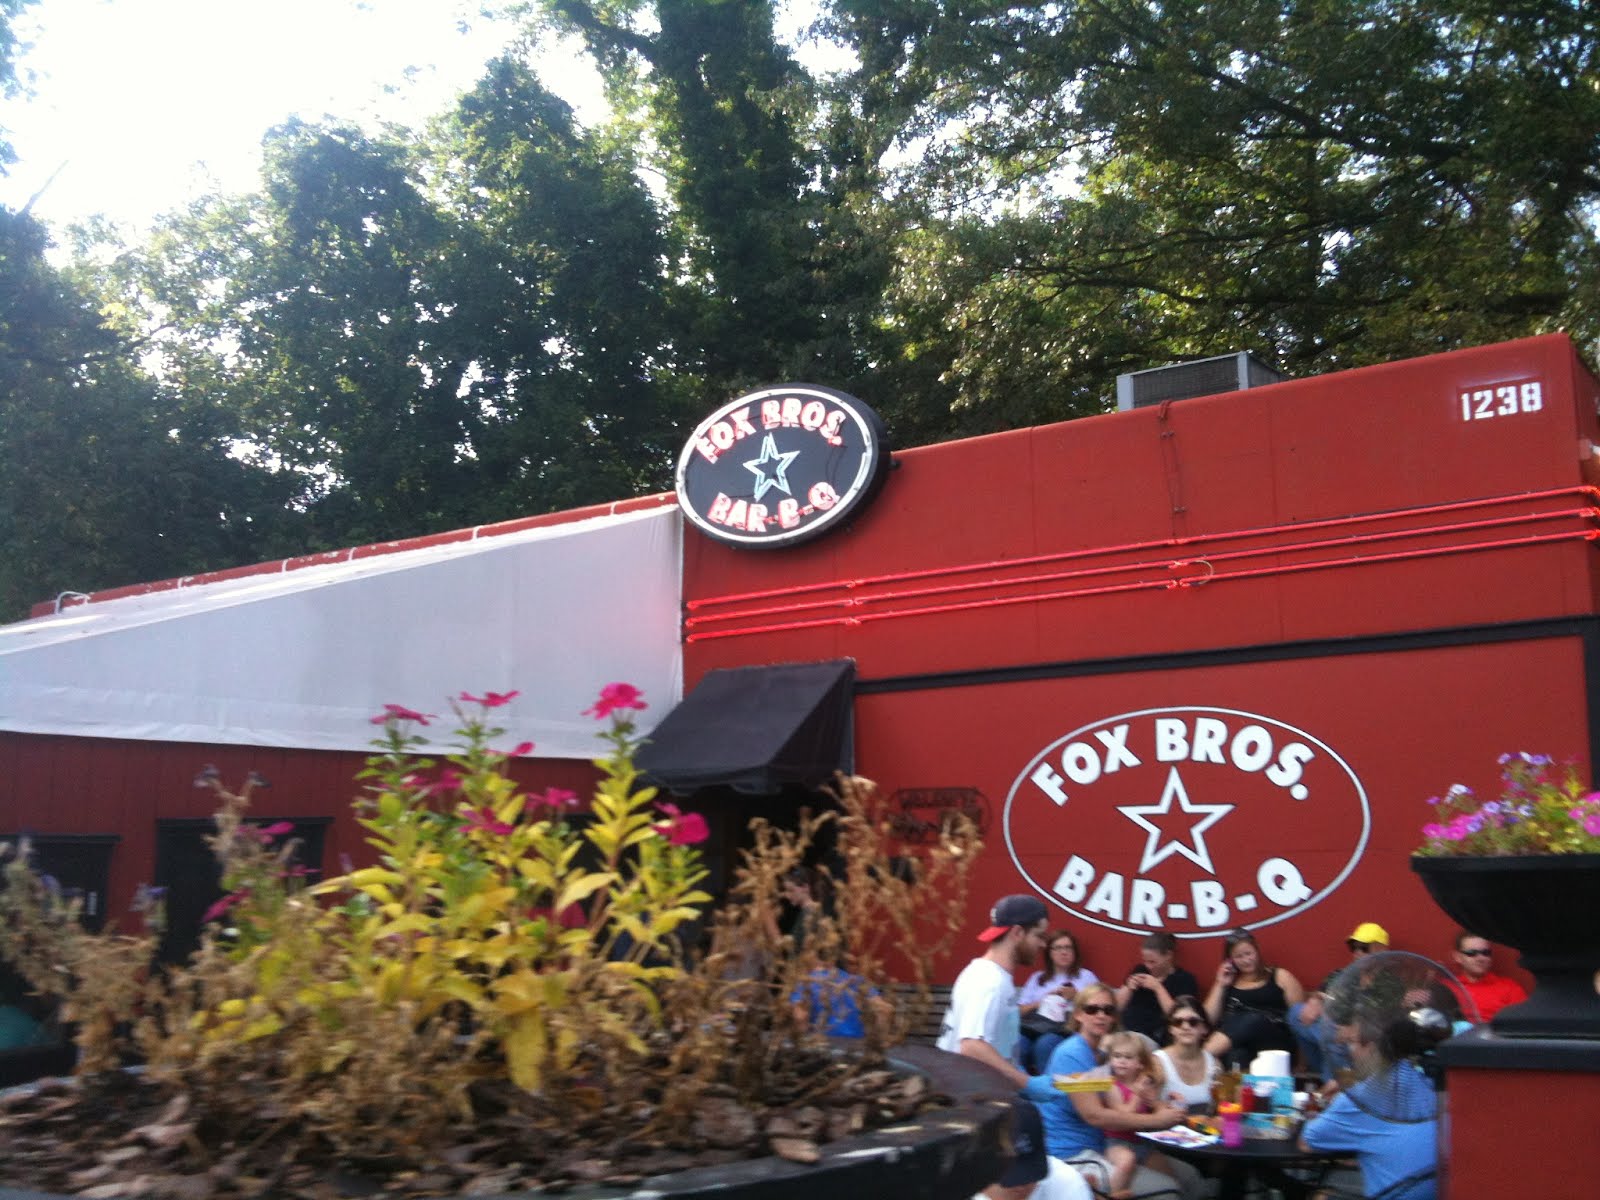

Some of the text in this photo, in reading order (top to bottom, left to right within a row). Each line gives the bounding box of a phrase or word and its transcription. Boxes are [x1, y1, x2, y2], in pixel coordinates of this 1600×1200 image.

[1461, 381, 1542, 421] 1238
[696, 406, 757, 464] FOX
[707, 481, 840, 533] BAR-B-Q
[1030, 716, 1315, 807] FOX BROS.
[1052, 853, 1313, 928] BAR-B-Q
